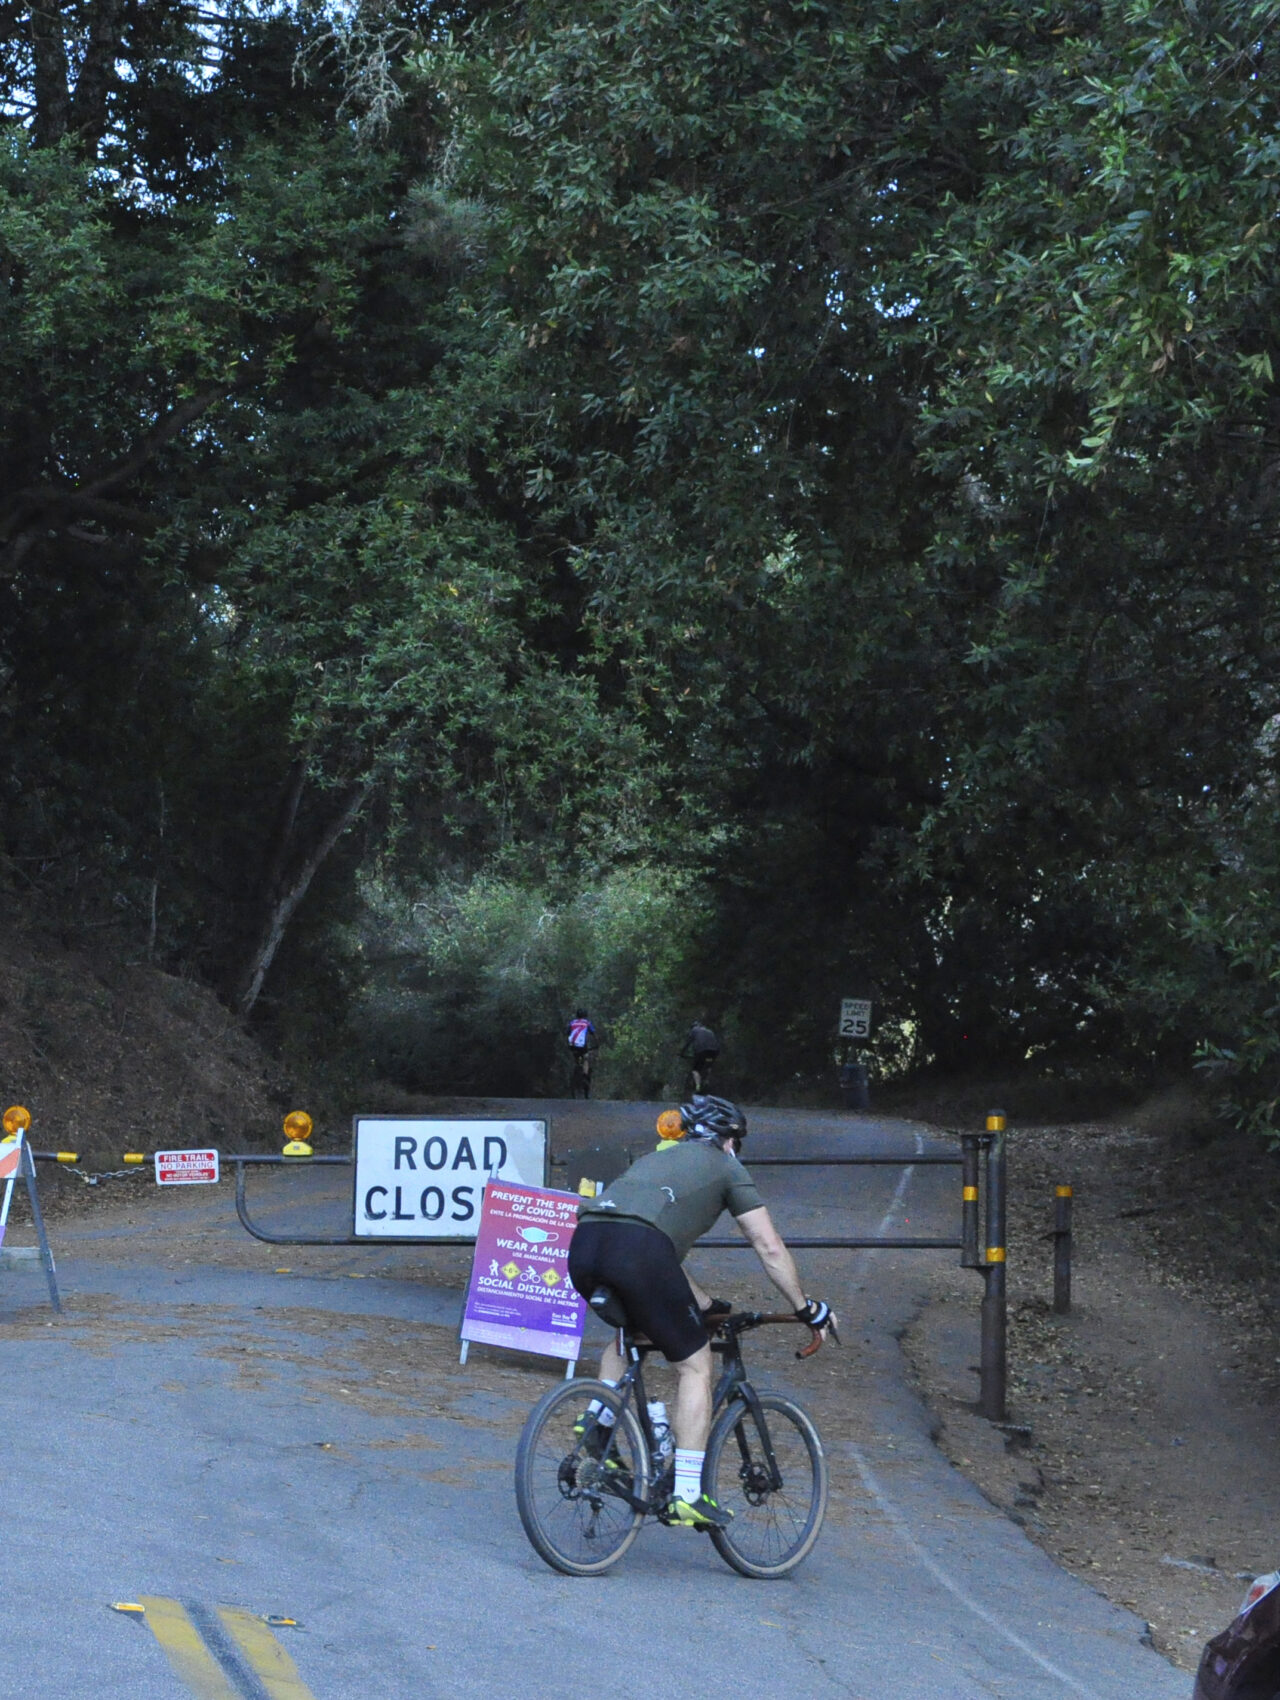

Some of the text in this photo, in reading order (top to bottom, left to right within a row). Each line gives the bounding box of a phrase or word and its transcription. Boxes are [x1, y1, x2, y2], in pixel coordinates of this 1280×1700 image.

[842, 1019, 867, 1035] 25
[185, 1153, 208, 1161] TRAIL
[393, 1136, 507, 1171] ROAD
[364, 1186, 485, 1221] CLOS
[490, 1190, 579, 1212] PREVENT THE SPRE
[512, 1204, 569, 1220] OF COVID-19
[496, 1238, 528, 1251] WEAR
[530, 1244, 538, 1253] A
[523, 1254, 555, 1263] MASCARILLA
[478, 1276, 514, 1290] SOCIAL
[517, 1283, 568, 1299] DISTANCE
[525, 1294, 542, 1302] SOCIAL
[557, 1299, 579, 1308] METROS
